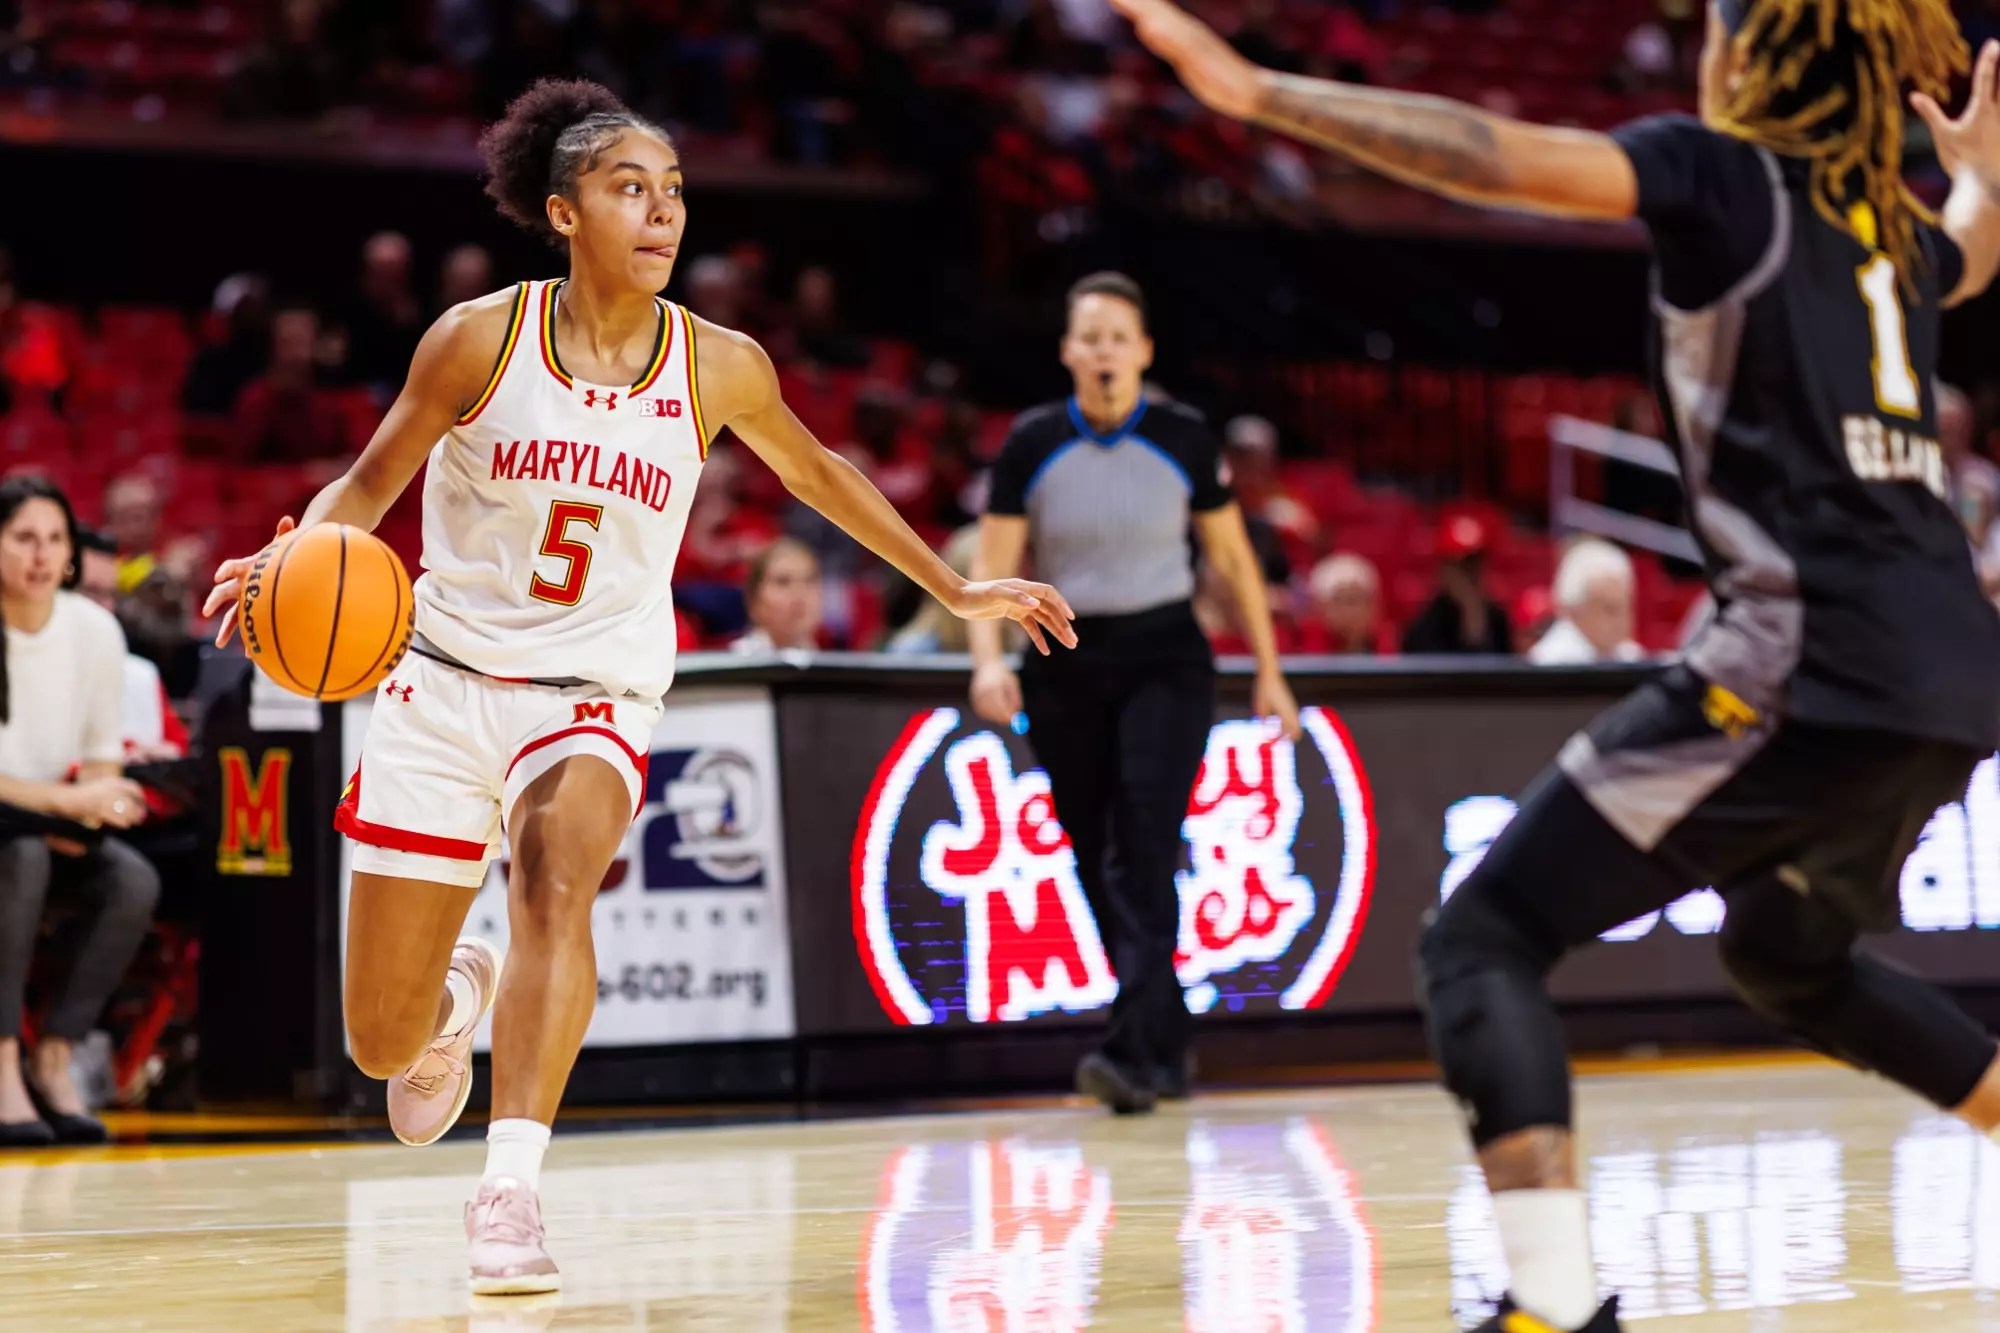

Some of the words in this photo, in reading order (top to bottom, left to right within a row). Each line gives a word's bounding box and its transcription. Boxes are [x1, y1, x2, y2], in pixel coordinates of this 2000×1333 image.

[1855, 250, 1921, 420] 1
[490, 439, 672, 513] MARYLAND
[529, 499, 604, 607] 5
[571, 701, 616, 726] M
[217, 746, 292, 876] M
